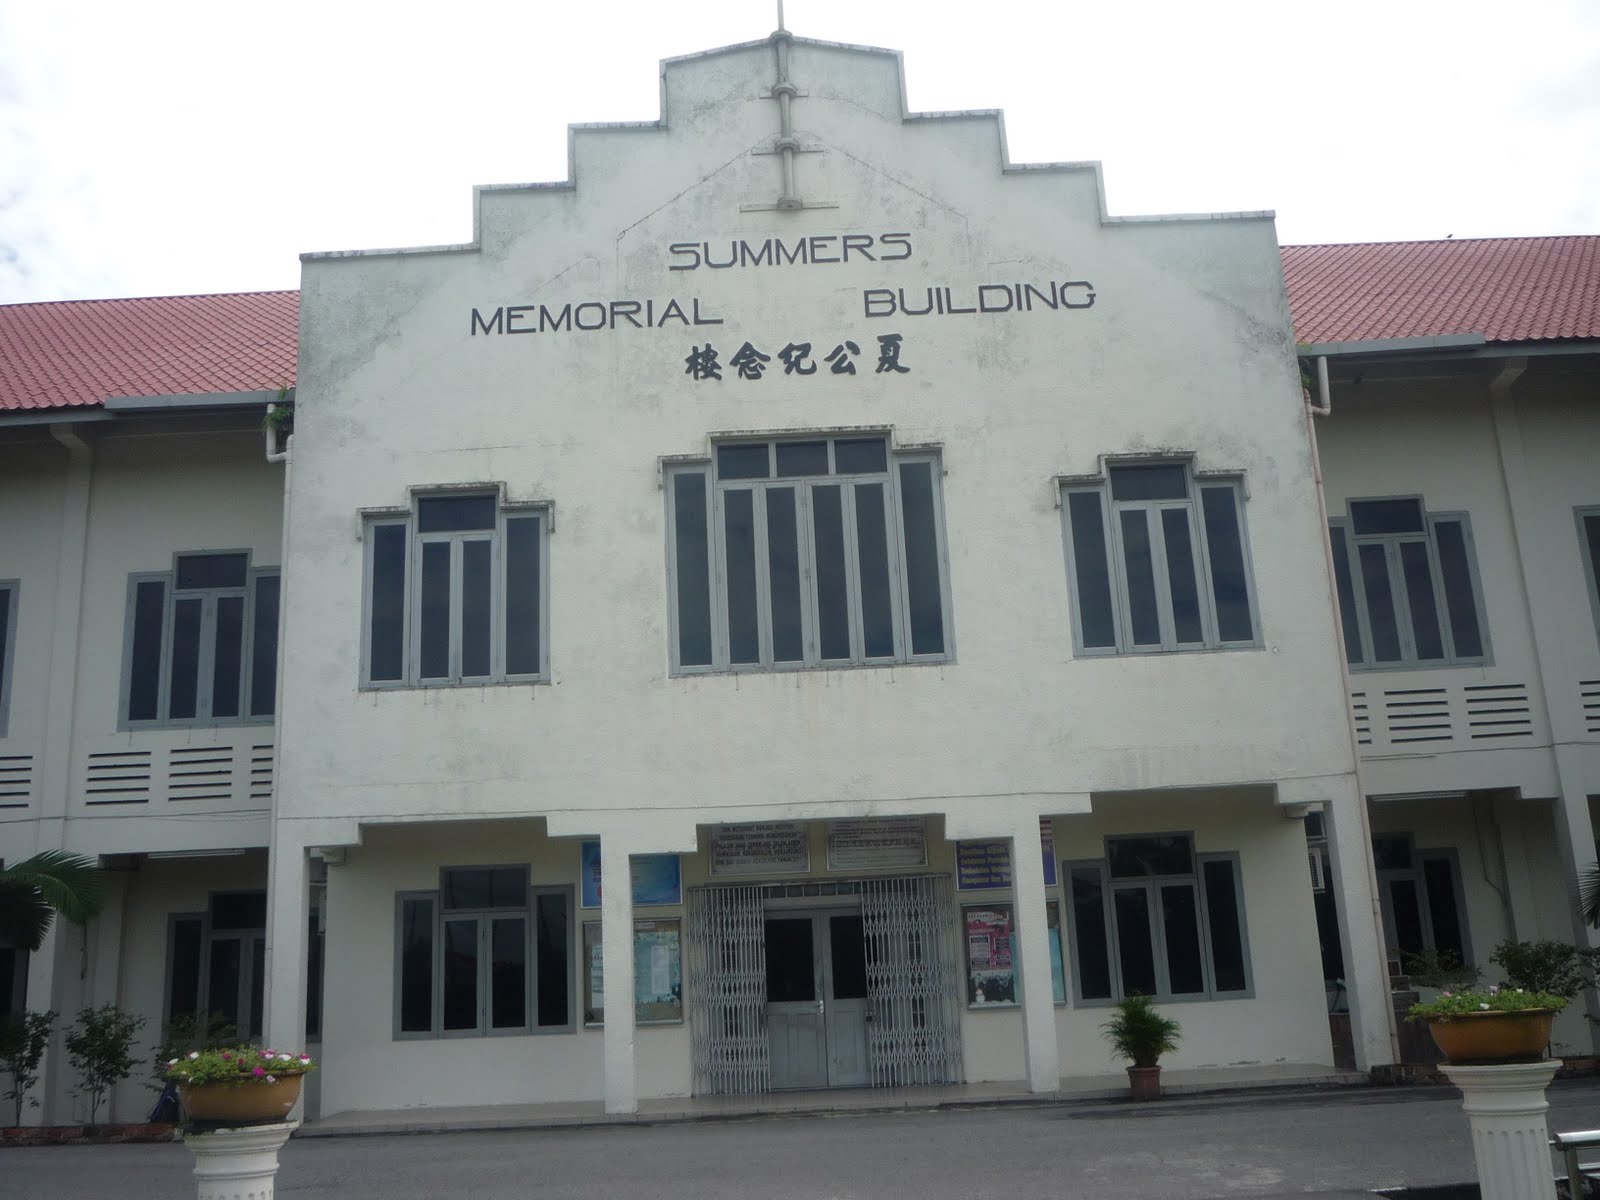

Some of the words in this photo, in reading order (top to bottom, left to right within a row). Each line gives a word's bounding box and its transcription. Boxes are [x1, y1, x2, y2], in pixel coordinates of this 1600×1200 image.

[669, 233, 911, 270] SUMMERS
[471, 298, 724, 336] MEMORIAL
[864, 282, 1096, 317] BUILDING
